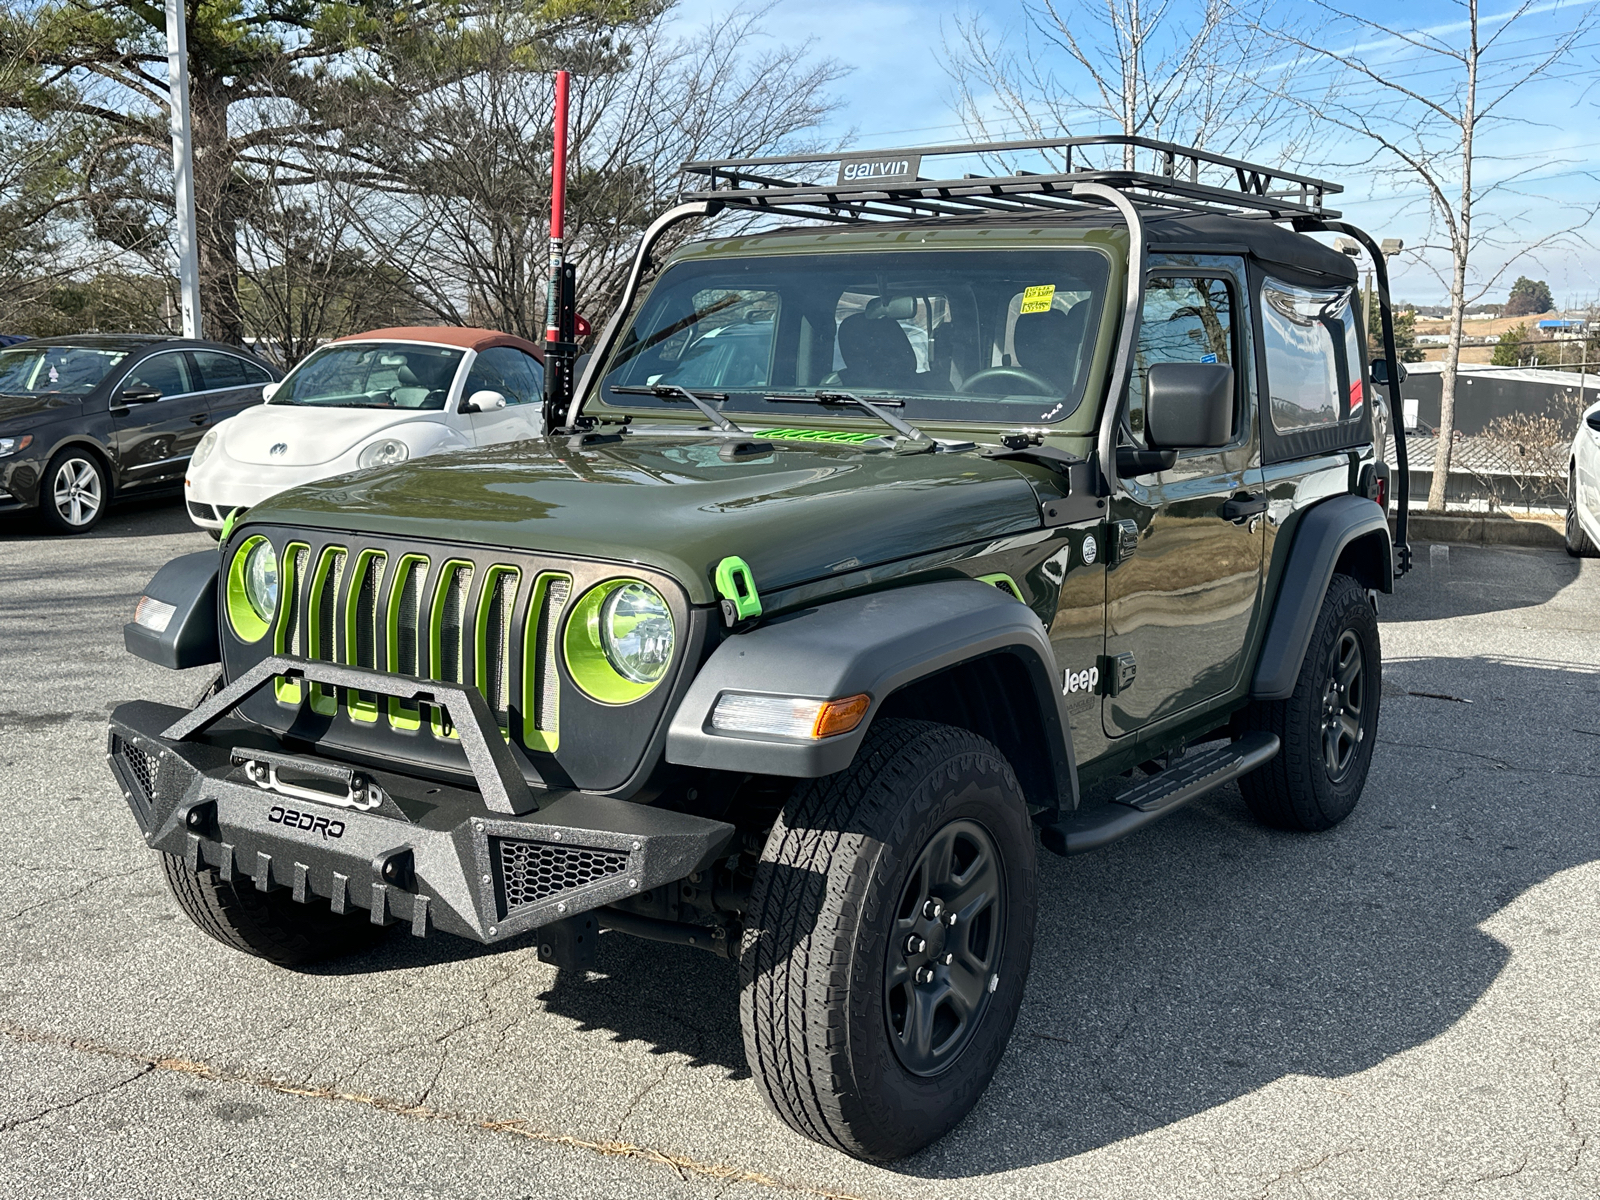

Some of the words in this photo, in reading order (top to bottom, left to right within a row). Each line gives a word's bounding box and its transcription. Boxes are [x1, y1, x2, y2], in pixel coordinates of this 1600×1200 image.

[844, 161, 909, 181] garvin
[1062, 666, 1099, 697] Jeep
[1066, 696, 1095, 710] ANGLER
